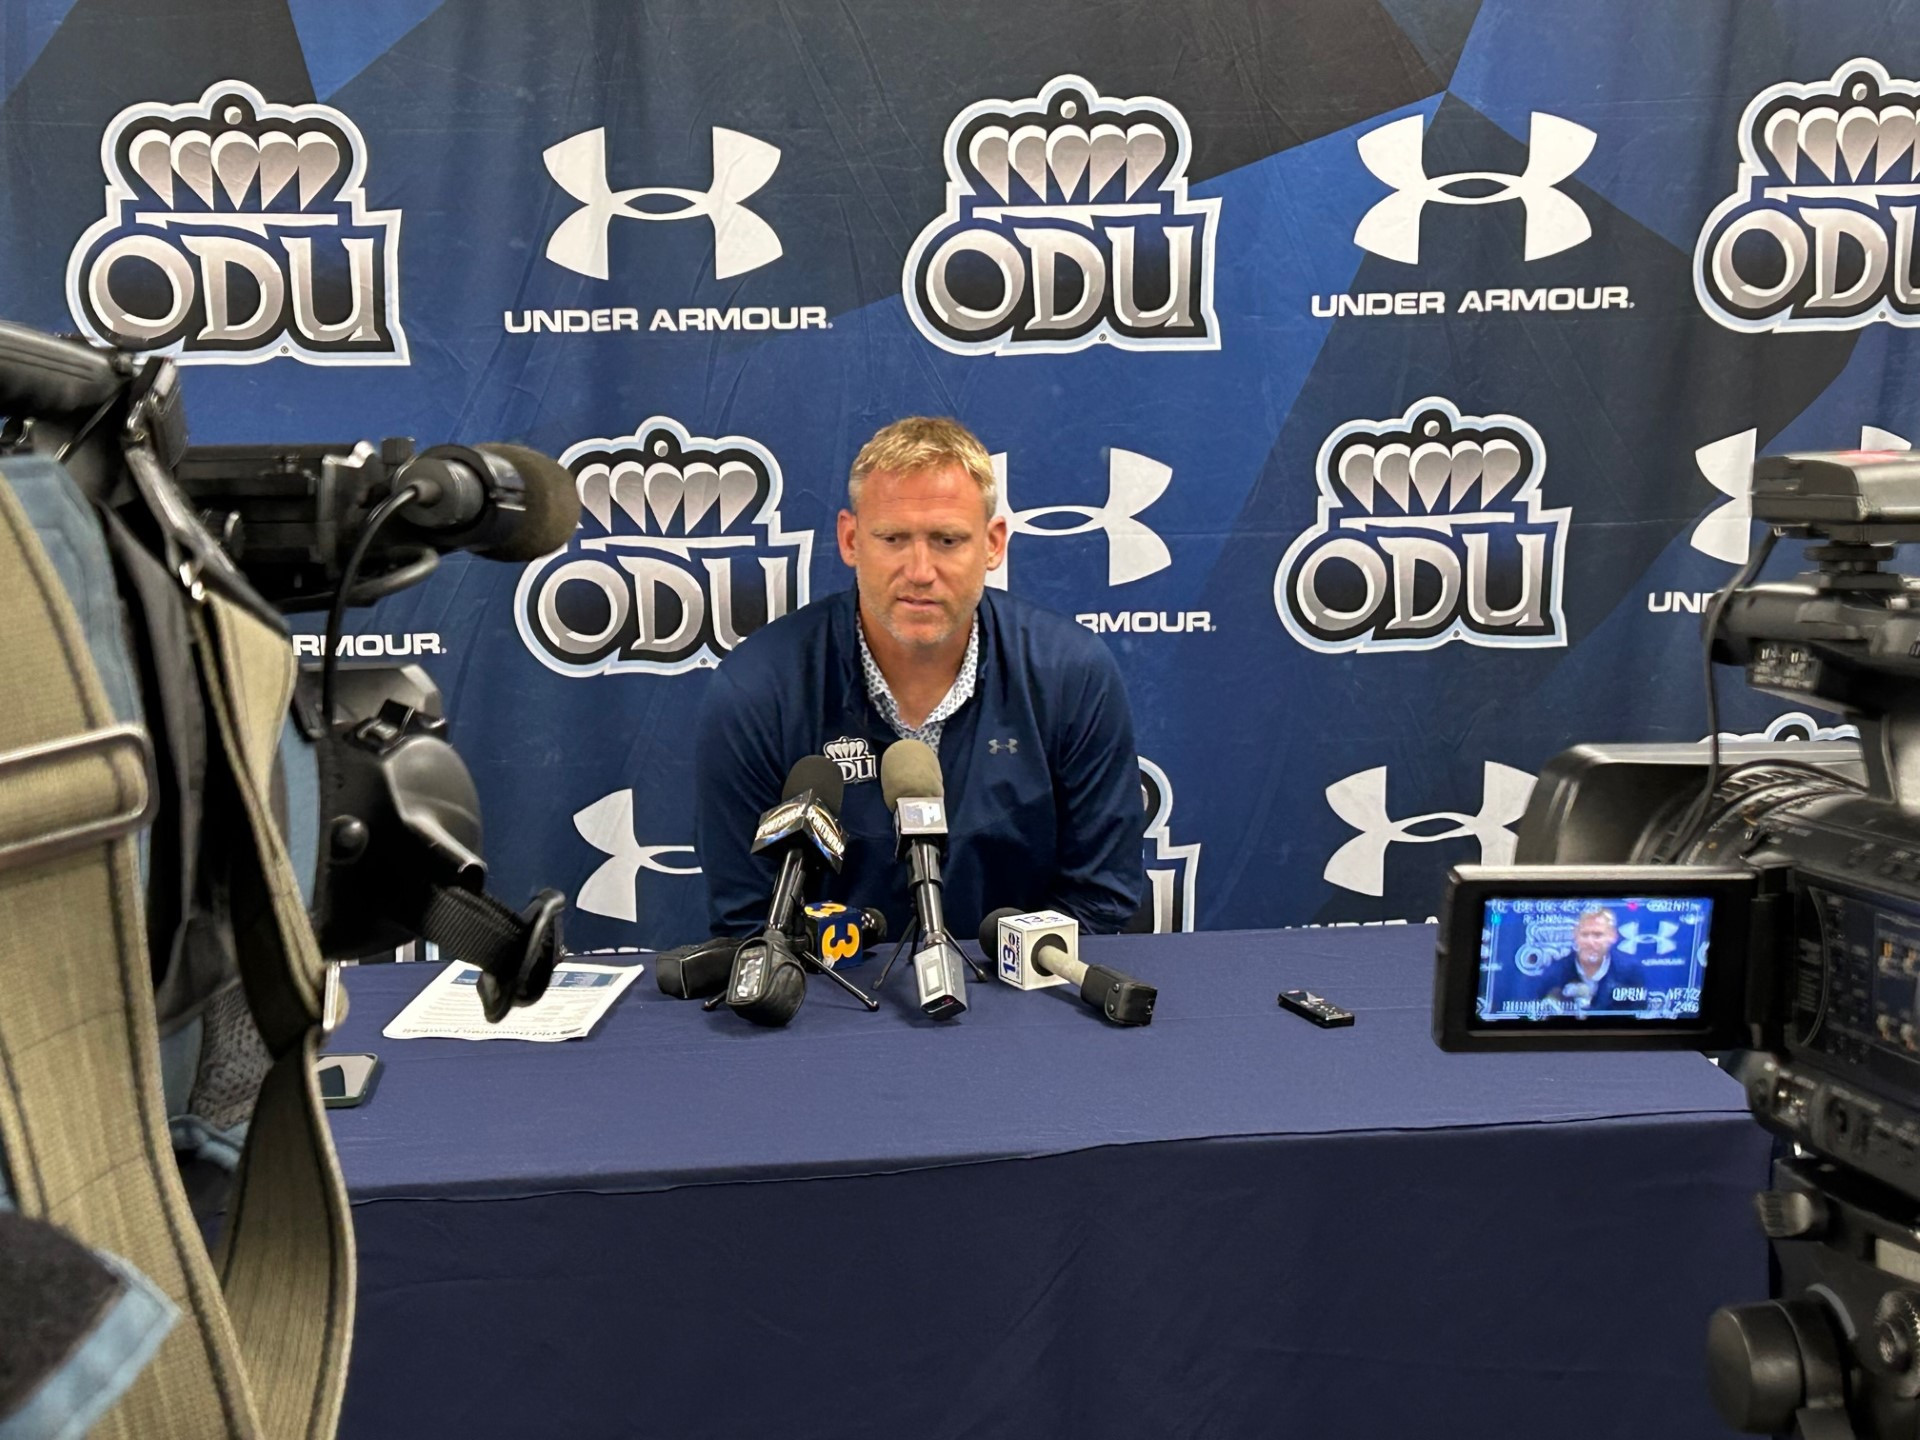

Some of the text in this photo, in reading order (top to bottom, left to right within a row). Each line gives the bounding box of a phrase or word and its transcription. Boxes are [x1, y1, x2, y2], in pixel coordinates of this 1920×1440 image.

[88, 234, 381, 341] ODU
[926, 223, 1195, 330] ODU
[1311, 291, 1446, 317] UNDER
[504, 308, 639, 333] UNDER
[1296, 532, 1545, 631] ODU
[537, 555, 788, 655] ODU
[1075, 611, 1213, 634] RMOUR
[292, 632, 442, 656] RMOUR
[837, 758, 875, 781] DU
[822, 923, 860, 962] 3
